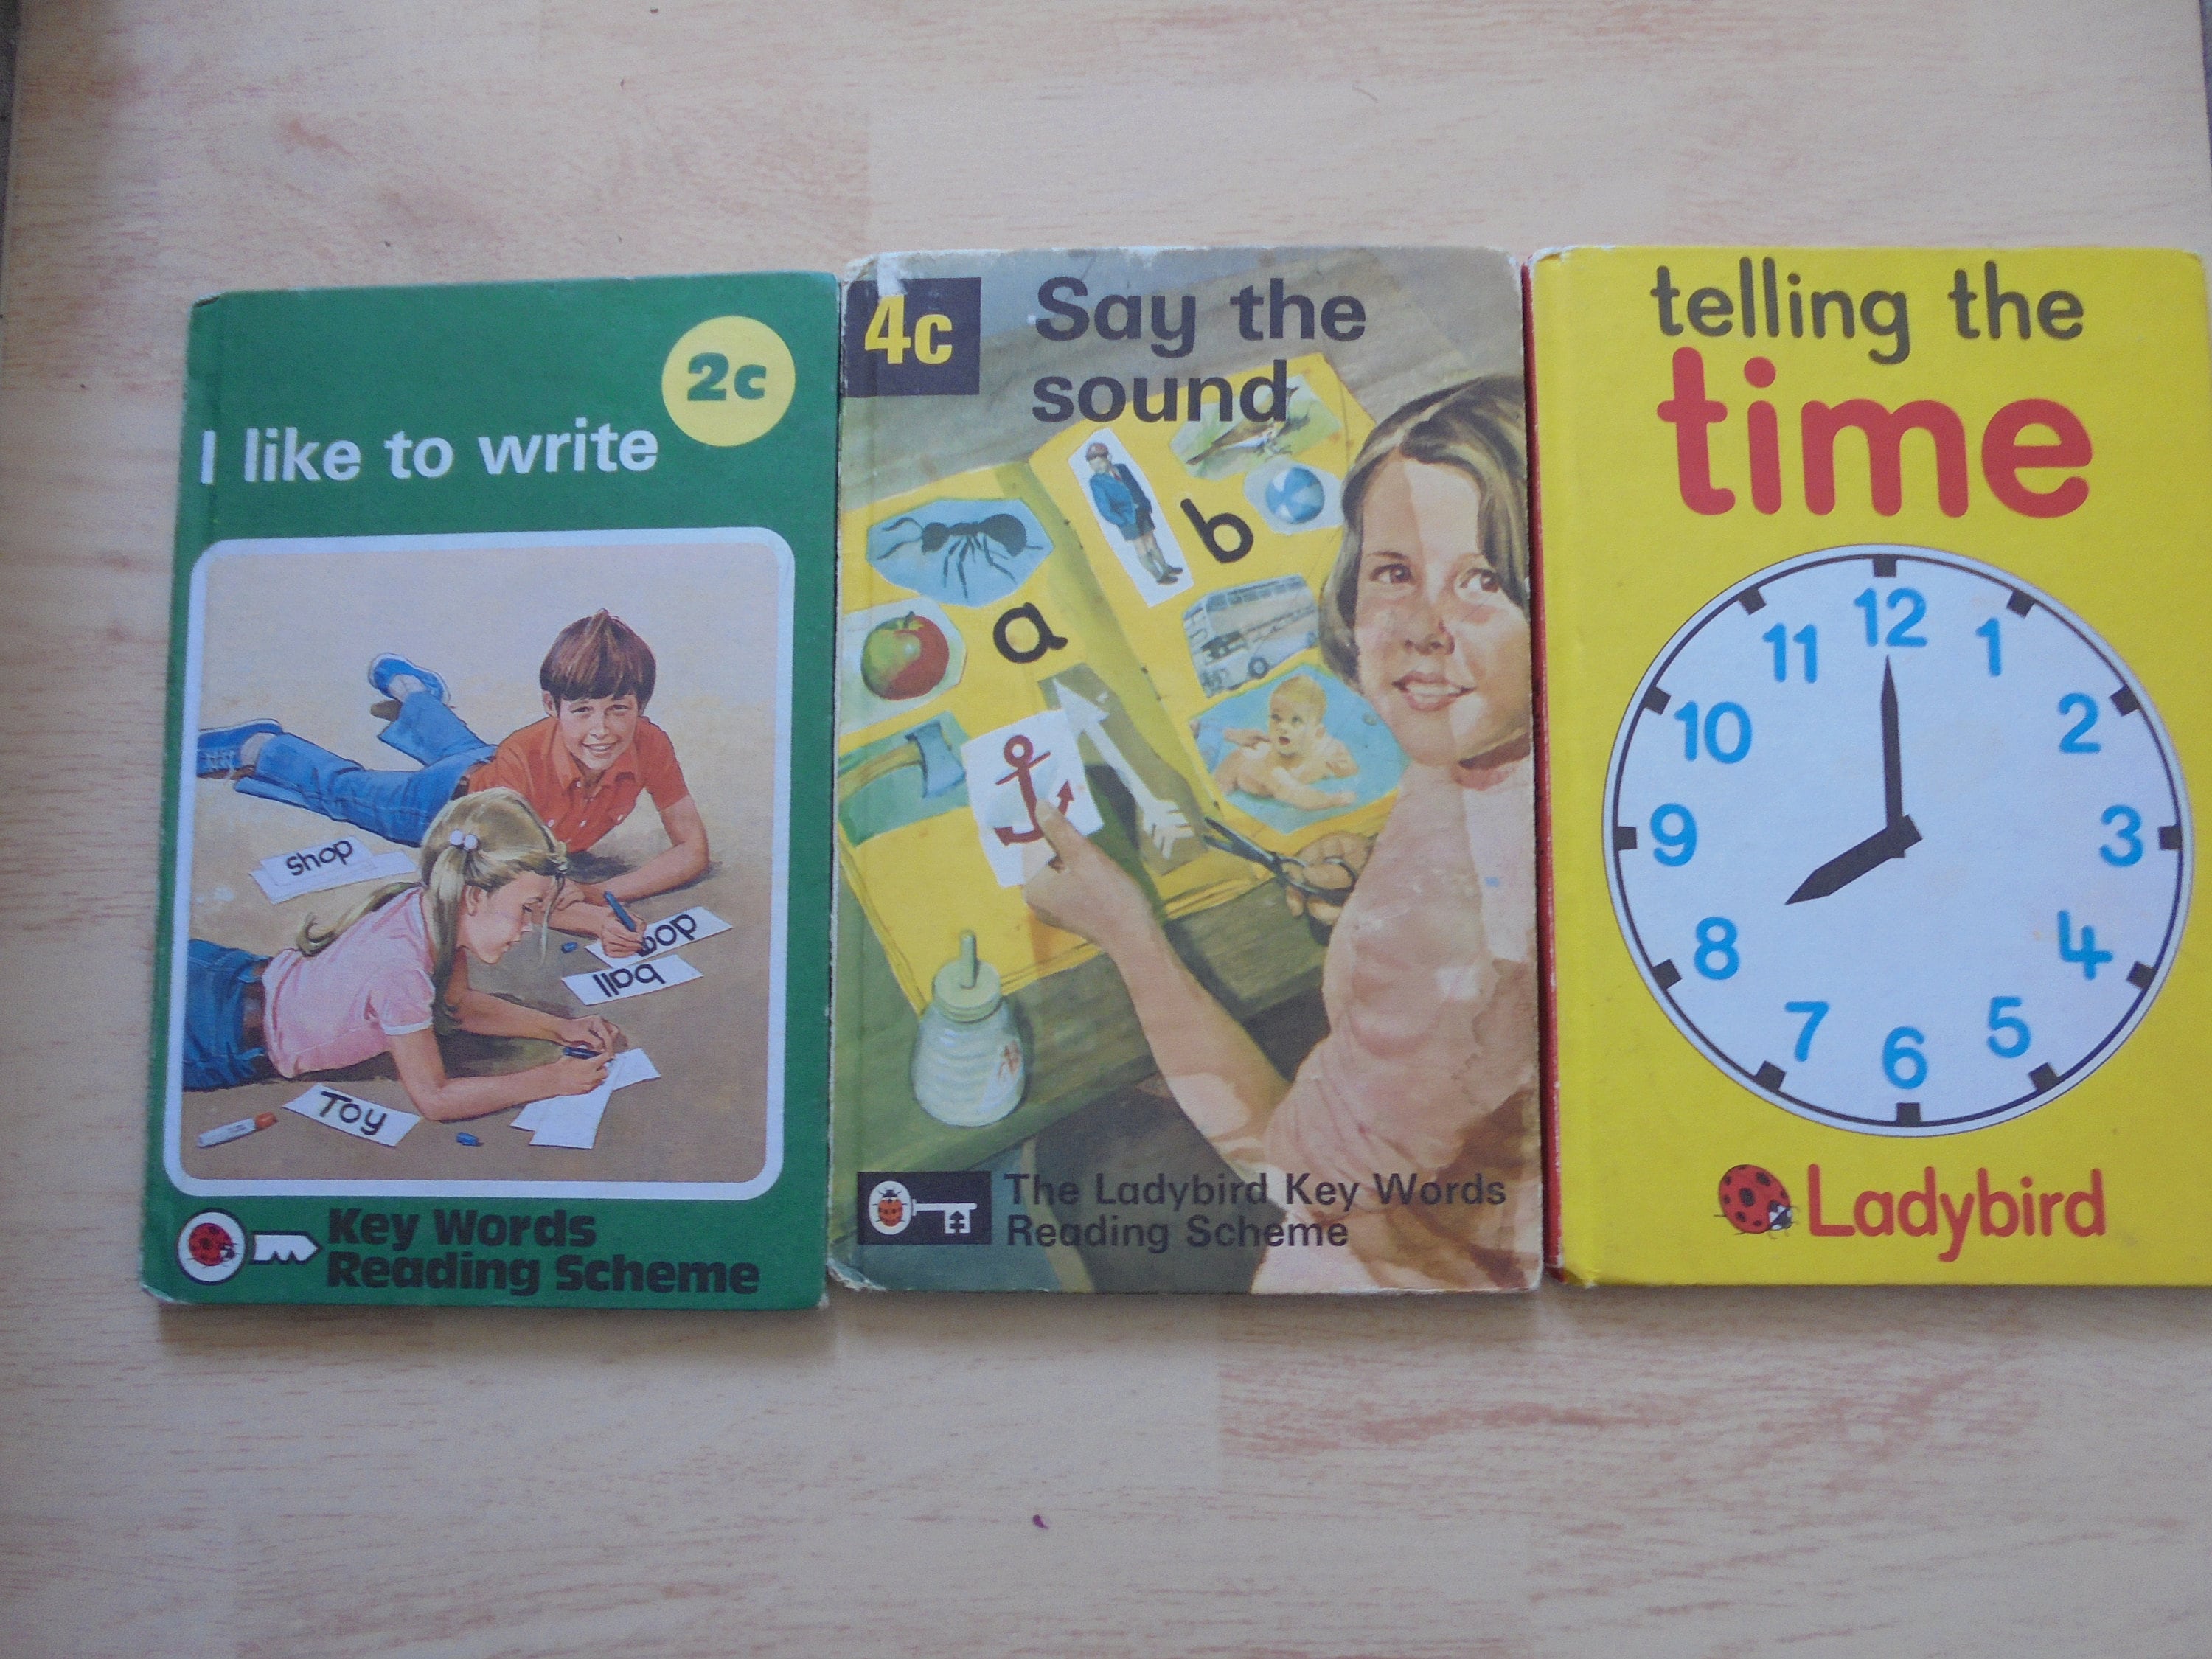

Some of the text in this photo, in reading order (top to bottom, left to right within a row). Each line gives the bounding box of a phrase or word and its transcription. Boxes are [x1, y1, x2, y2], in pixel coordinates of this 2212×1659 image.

[864, 295, 953, 364] 4c
[1036, 276, 1366, 358] Say the
[1651, 257, 2084, 365] telling the
[688, 352, 767, 401] 2c
[1032, 359, 1287, 424] sound
[201, 418, 658, 484] I like to write
[1657, 347, 2093, 518] time
[1180, 498, 1253, 563] b
[993, 603, 1068, 664] a
[1854, 588, 1927, 649] 12
[1976, 618, 2001, 677] 1
[1762, 623, 1817, 684] 11
[1674, 701, 1752, 764] 10
[2059, 692, 2101, 754] 2
[285, 838, 352, 877] shop
[1650, 804, 1697, 866] 9
[2099, 805, 2144, 866] 3
[1694, 917, 1739, 980] 8
[2058, 909, 2112, 980] 4
[593, 964, 666, 997] ball
[1784, 1001, 1829, 1062] 7
[1882, 1026, 1928, 1089] 6
[1986, 996, 2031, 1058] 5
[320, 1091, 387, 1135] Toy
[1004, 1172, 1506, 1212] The Ladybird Key Words
[1808, 1164, 2106, 1262] Ladybird
[327, 1209, 596, 1250] Key Words
[1006, 1214, 1348, 1253] Reading Scheme
[327, 1252, 759, 1294] Reading Scheme
